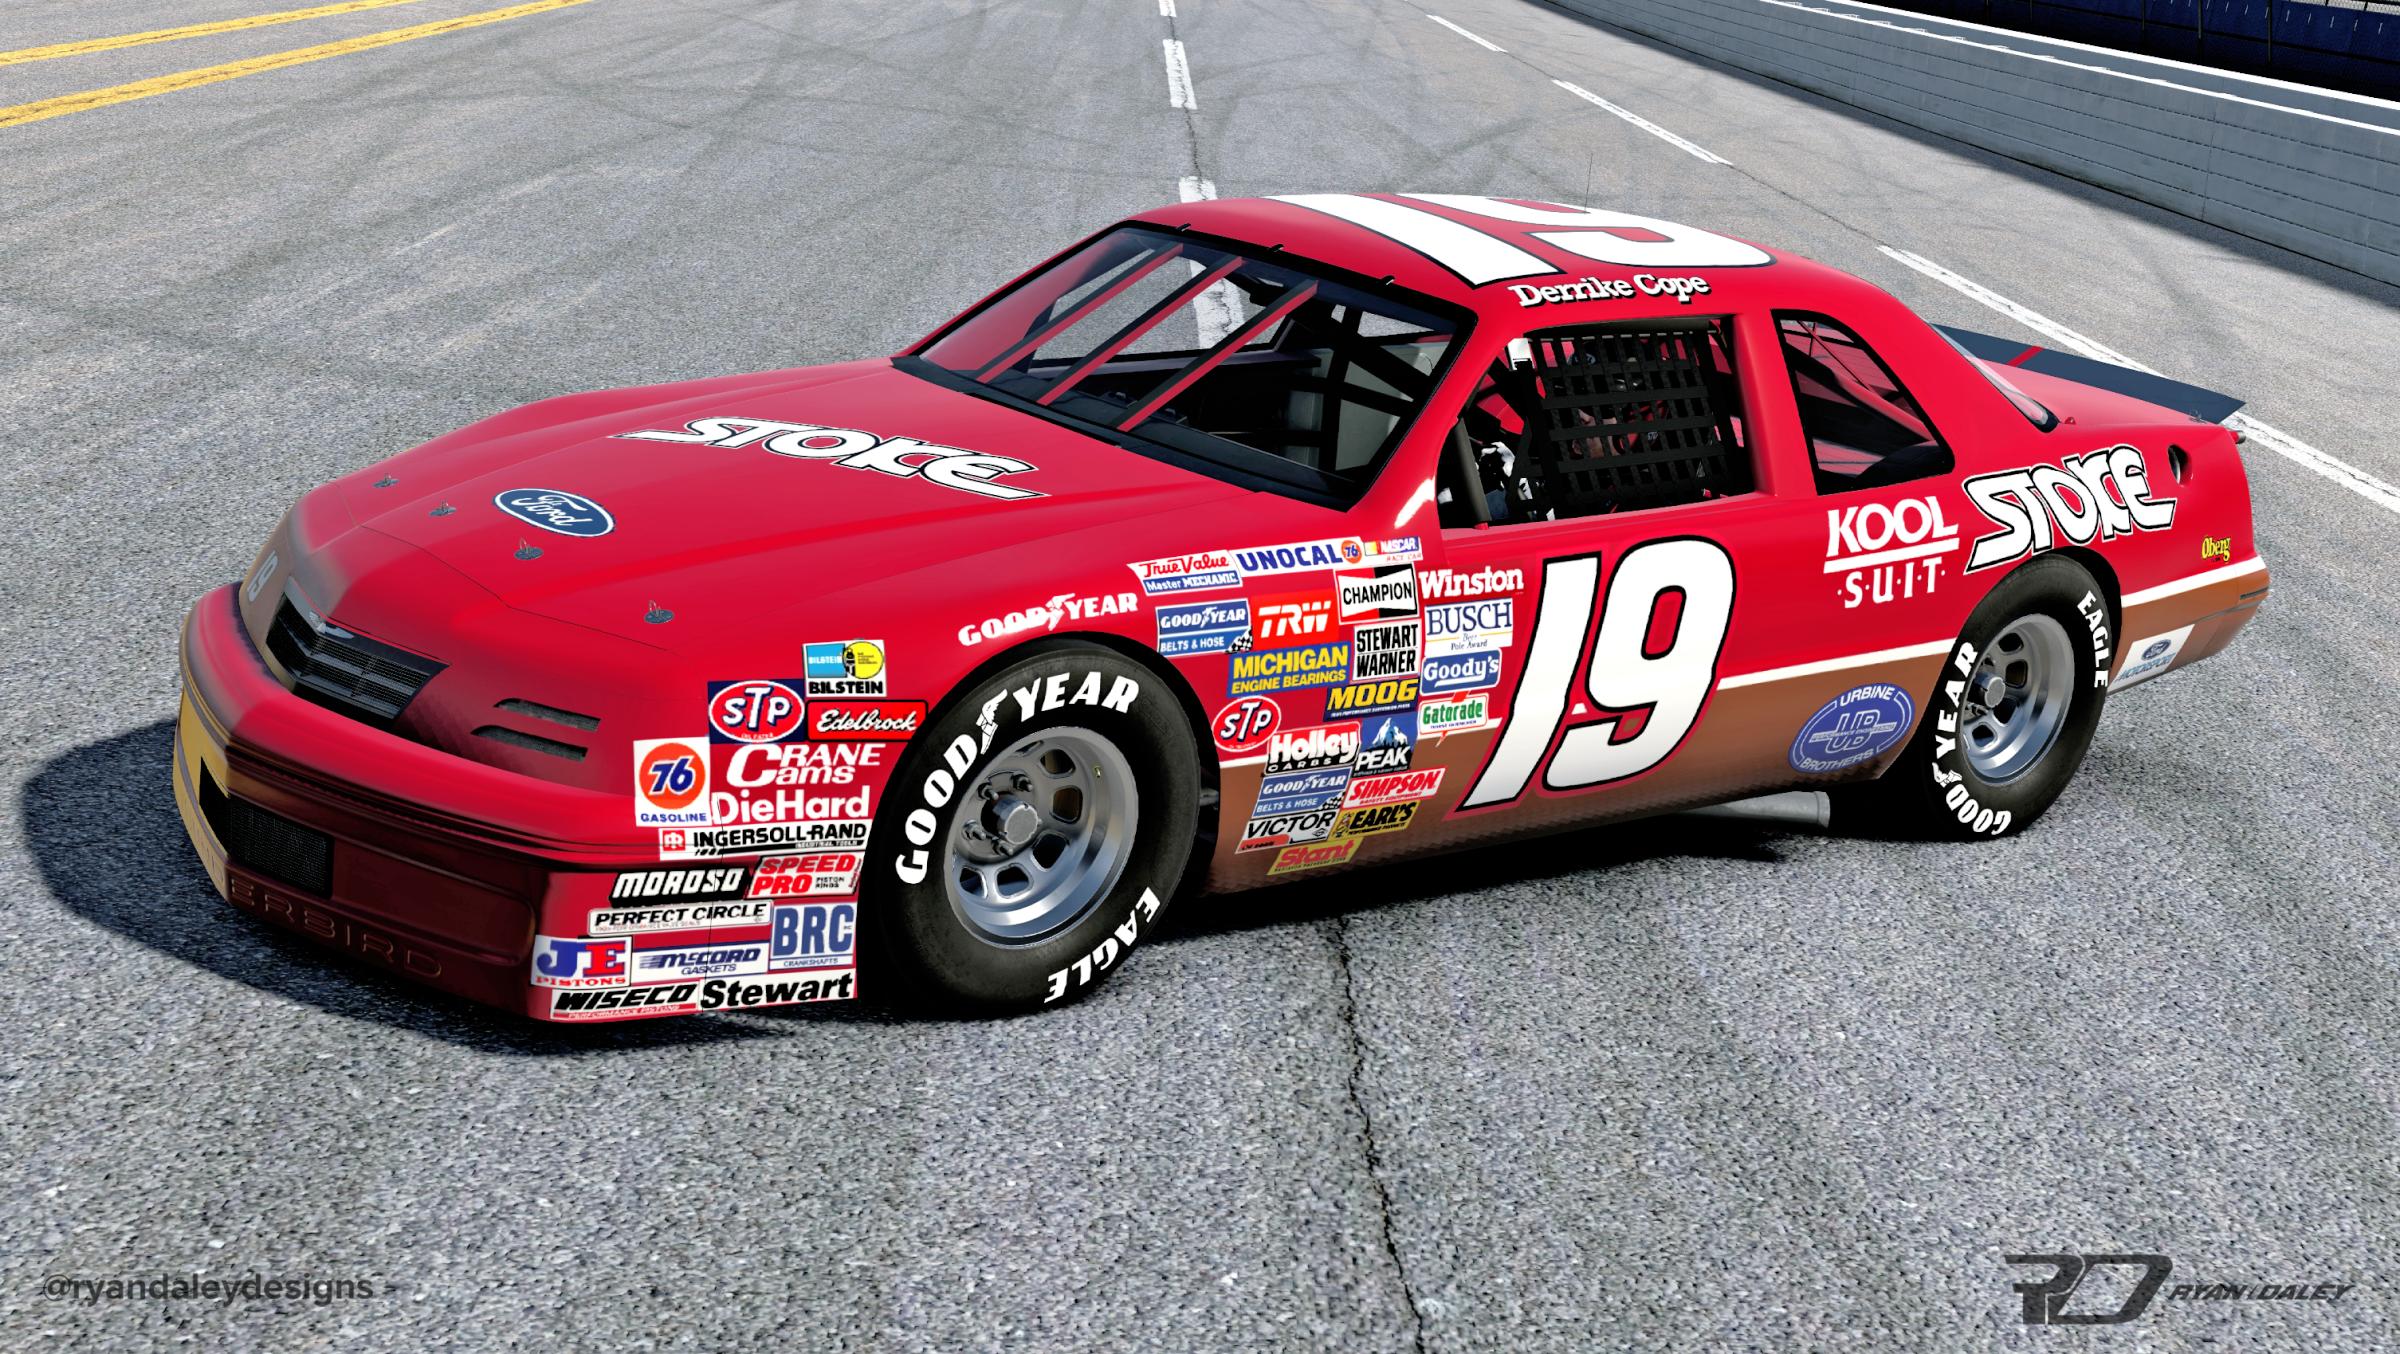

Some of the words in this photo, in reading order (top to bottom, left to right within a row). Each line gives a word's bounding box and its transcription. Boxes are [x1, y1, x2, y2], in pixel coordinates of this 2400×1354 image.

[1260, 192, 1777, 290] 19
[1507, 276, 1637, 308] Derrike
[1633, 273, 1711, 304] Cope
[511, 494, 593, 526] Ford
[1825, 496, 1959, 558] KOOL
[1236, 543, 1343, 572] UNOCAL
[1344, 544, 1359, 557] 76
[1380, 537, 1417, 553] NASCAR
[1145, 579, 1181, 592] Master
[1182, 572, 1238, 588] MECHANIC
[1343, 581, 1413, 606] CHAMPION
[1418, 566, 1524, 599] Winston
[1258, 600, 1331, 638] TRW
[1426, 602, 1512, 635] BUSCH
[1160, 640, 1188, 652] BELTS
[1191, 639, 1198, 649] &
[1200, 636, 1225, 648] HOSE
[1356, 624, 1418, 652] STEWART
[1450, 642, 1465, 650] Pole
[1467, 640, 1488, 649] Award
[2077, 590, 2109, 688] EAGLE
[1233, 645, 1348, 679] MICHIGAN
[1356, 651, 1416, 677] WARNER
[1424, 655, 1499, 688] Goody's
[1454, 535, 1737, 813] 19
[808, 681, 883, 694] BILSTEIN
[1231, 679, 1280, 694] ENGINE
[1283, 669, 1347, 688] BEARINGS
[1327, 678, 1419, 711] MOOG
[722, 687, 792, 731] STP
[1840, 685, 1895, 707] URBINE
[816, 708, 918, 732] Edelbrock
[1220, 702, 1273, 741] STP
[1423, 700, 1483, 724] Gatorade
[1269, 729, 1358, 763] Holley
[1354, 745, 1411, 772] PEAK
[1800, 748, 1874, 771] BROTHERS
[648, 755, 696, 795] 76
[1267, 757, 1332, 773] CARBS
[1349, 771, 1441, 800] SIMPSON
[640, 813, 707, 822] GASOLINE
[711, 785, 870, 825] DieHard
[1256, 801, 1284, 813] BELTS
[1294, 797, 1318, 808] HOSE
[1349, 801, 1417, 829] EARL'S
[693, 823, 867, 849] INGERSOLL-RAND
[1247, 811, 1336, 838] VICTOR
[760, 854, 856, 874] SPEED
[1275, 839, 1354, 869] Stant
[612, 867, 745, 899] MOROSO
[752, 874, 812, 895] PRO
[595, 908, 689, 926] PERFECT
[692, 903, 767, 921] CIRCLE
[773, 904, 854, 956] BRC
[536, 940, 626, 978] JE
[1043, 887, 1161, 1004] EAGLE
[681, 963, 736, 975] GASKETS
[783, 957, 839, 967] CRANKSHAFTS
[535, 977, 626, 987] PISTONS
[700, 973, 853, 1009] Stewart
[554, 984, 698, 1011] WISECO
